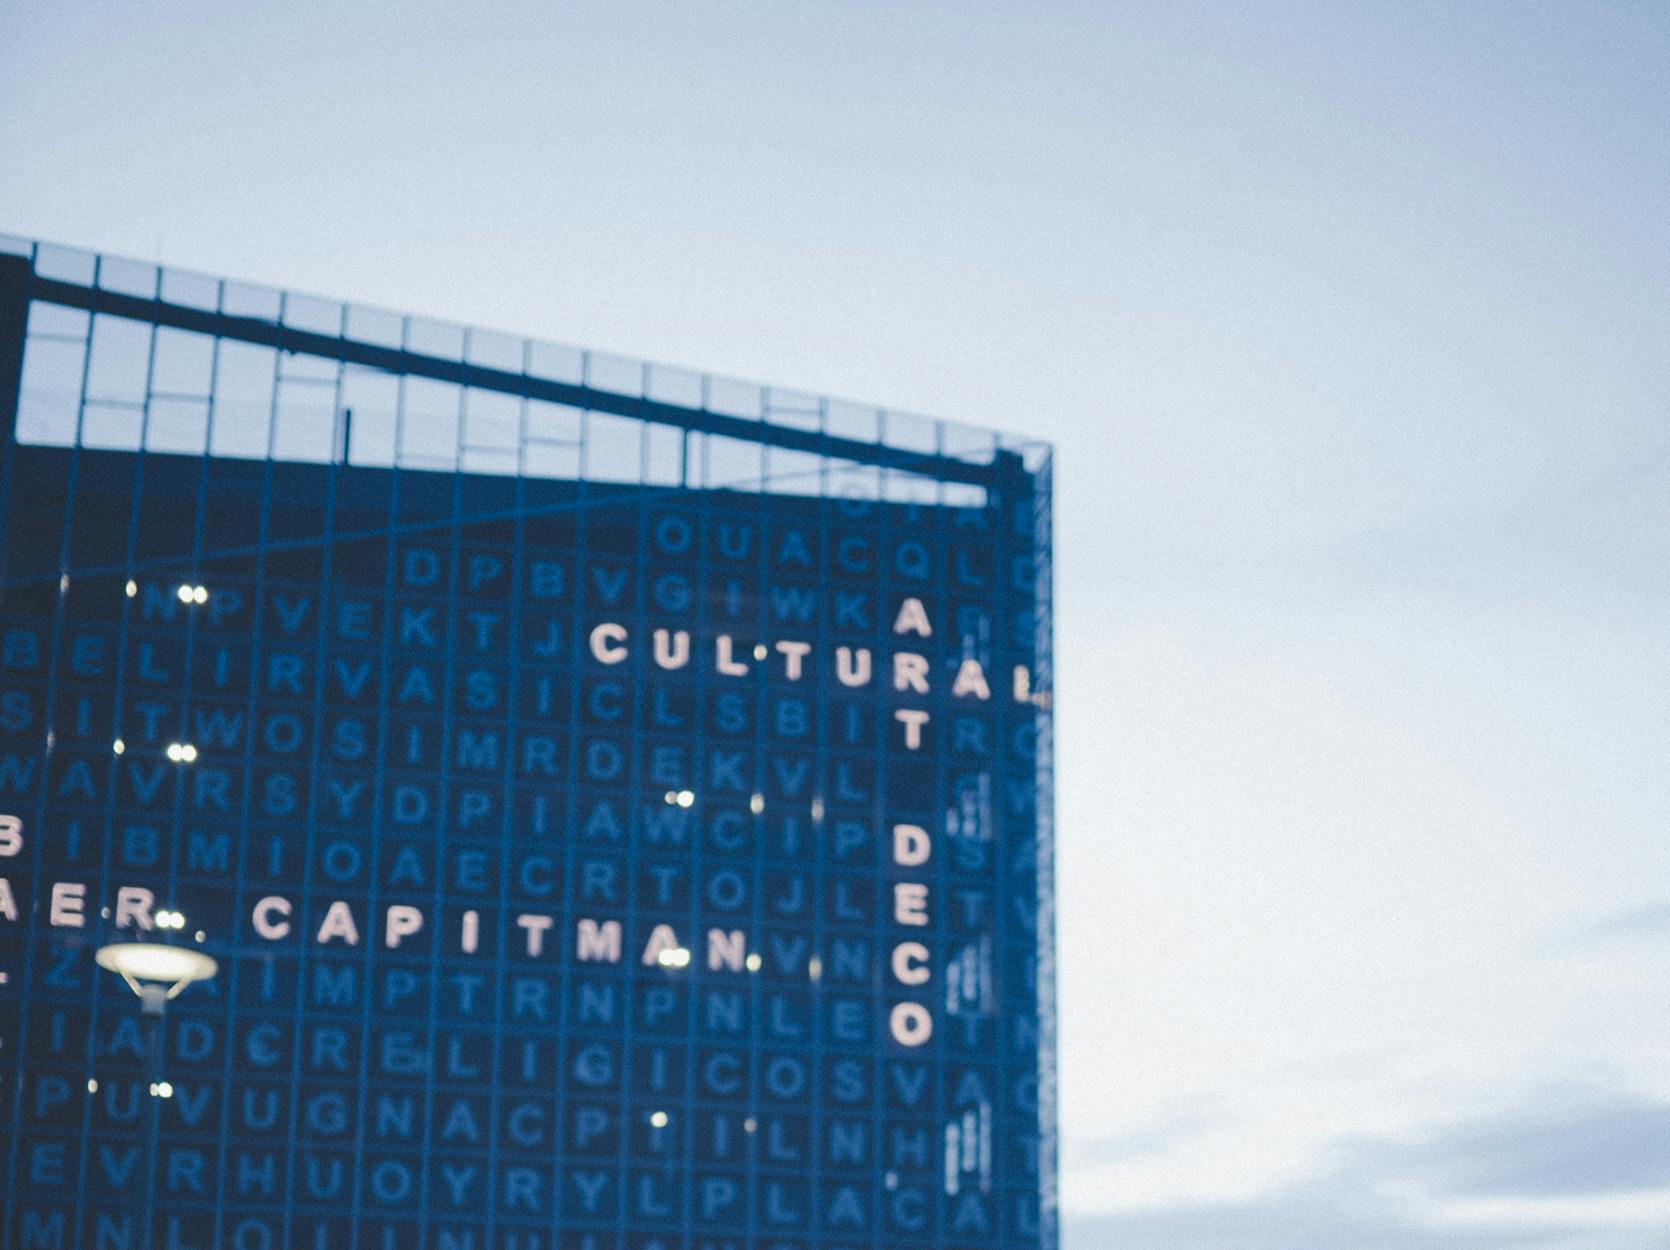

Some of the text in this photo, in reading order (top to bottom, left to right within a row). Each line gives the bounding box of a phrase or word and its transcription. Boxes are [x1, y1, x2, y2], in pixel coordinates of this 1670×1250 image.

[590, 623, 1046, 703] CULTURAL
[890, 595, 930, 1045] ART DECO
[250, 896, 744, 972] CAPITMAN
